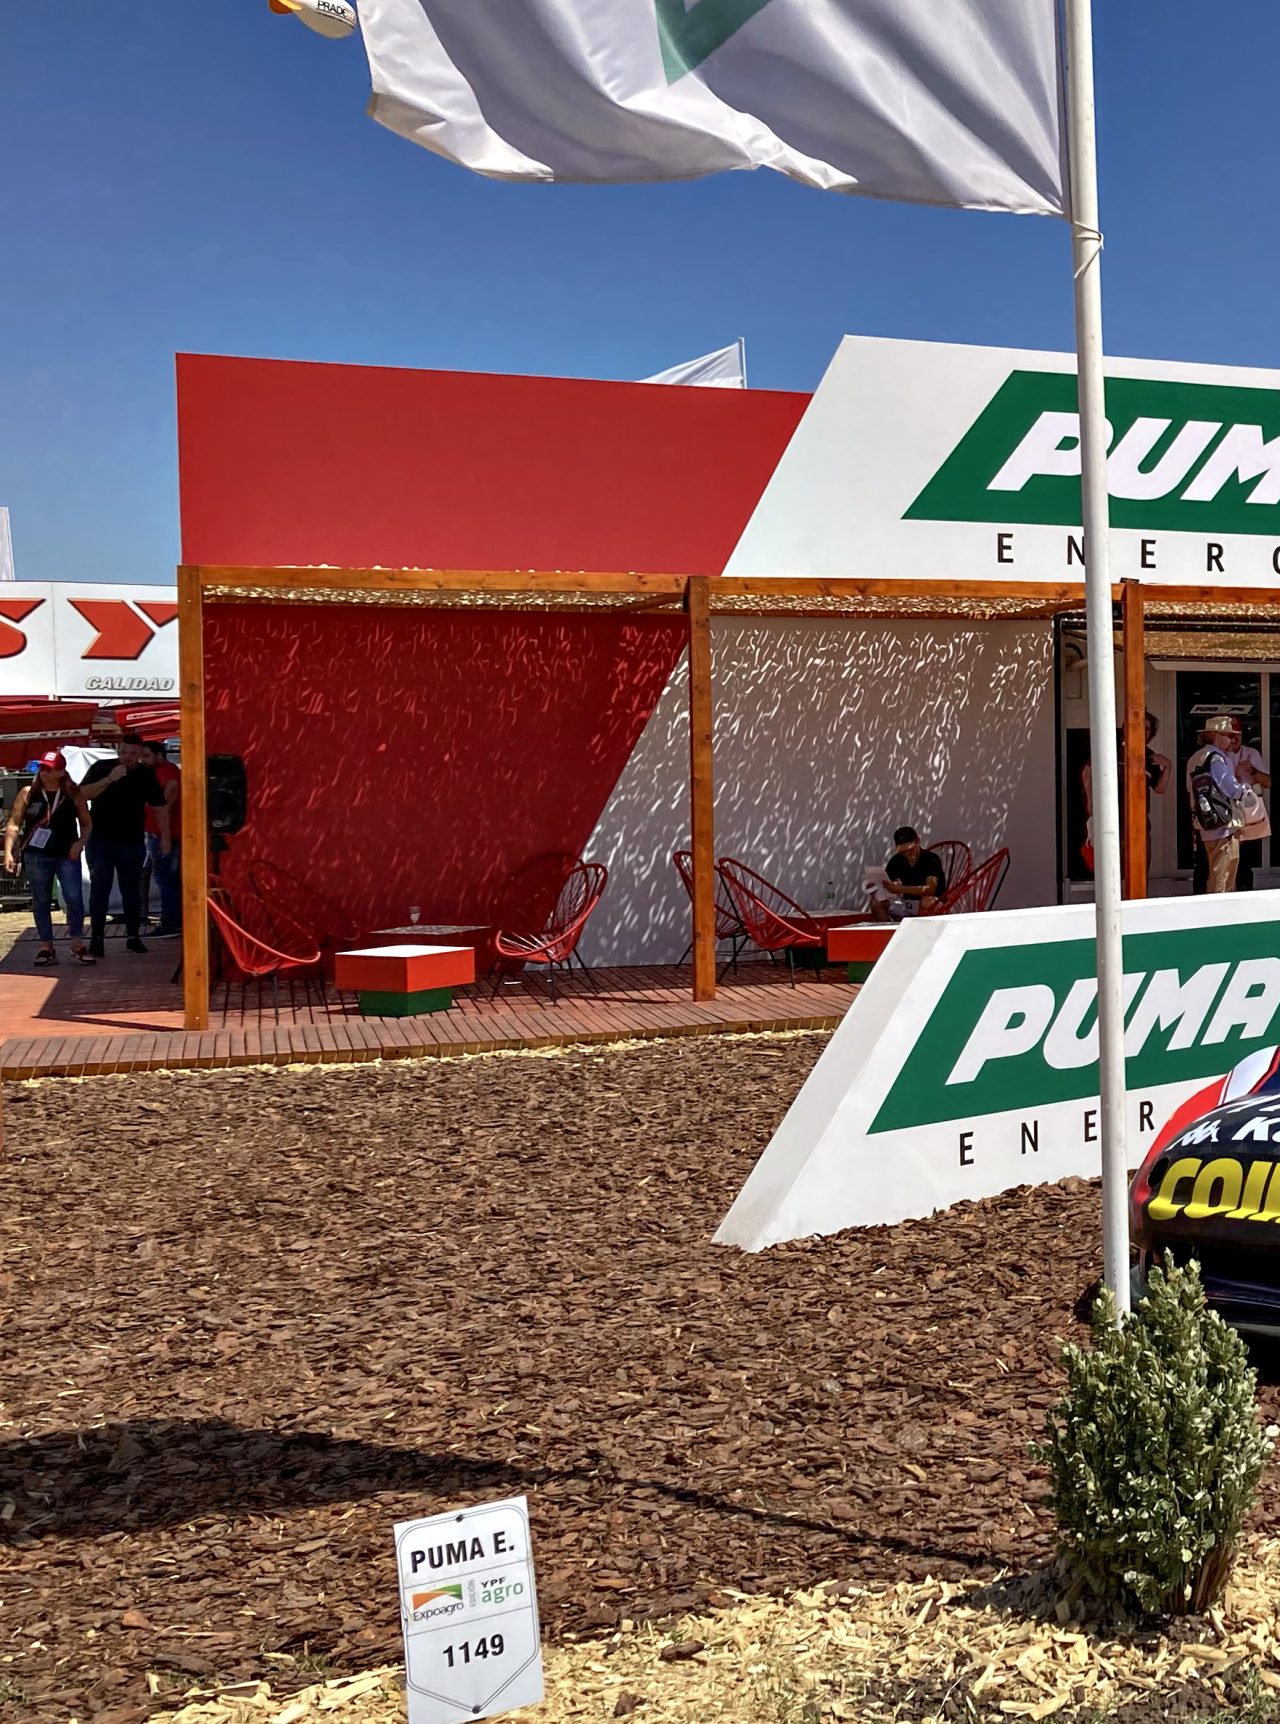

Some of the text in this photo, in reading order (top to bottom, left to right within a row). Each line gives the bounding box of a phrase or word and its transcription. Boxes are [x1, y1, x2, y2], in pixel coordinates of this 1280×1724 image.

[85, 676, 174, 691] CALIDAD
[411, 1531, 515, 1573] PUMA E.
[481, 1577, 506, 1588] YPF
[481, 1582, 524, 1604] agro
[413, 1602, 464, 1622] Expoagro
[442, 1633, 505, 1668] 1149
